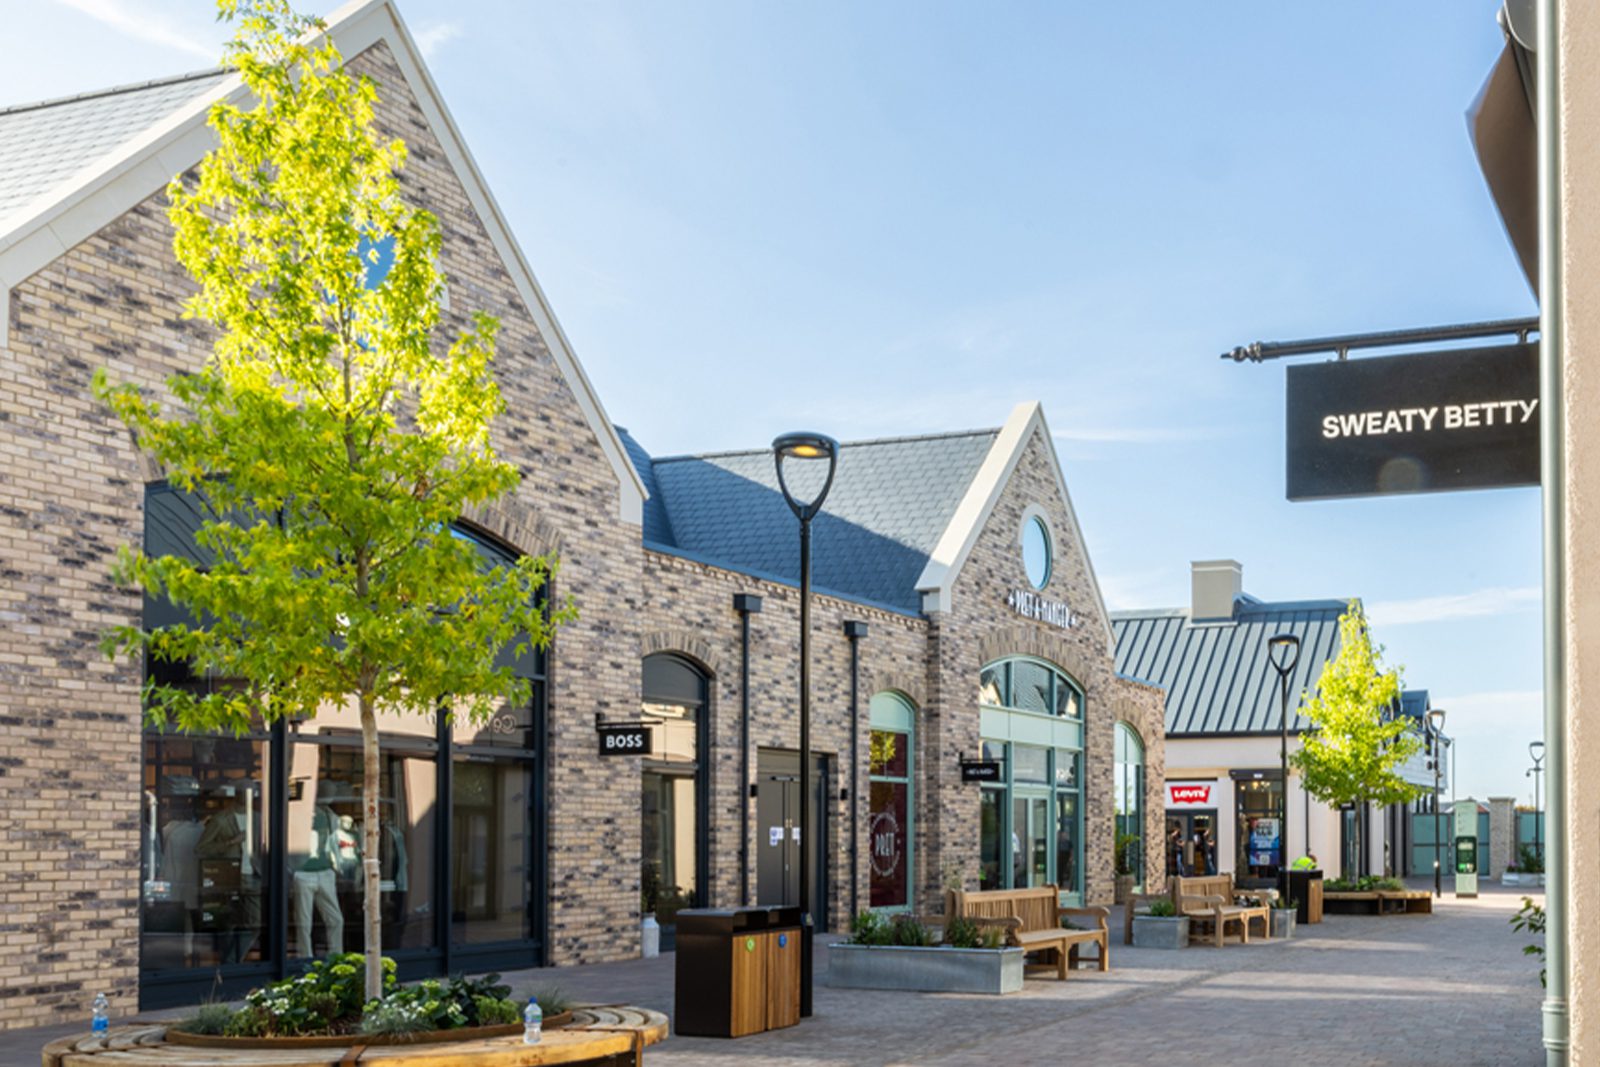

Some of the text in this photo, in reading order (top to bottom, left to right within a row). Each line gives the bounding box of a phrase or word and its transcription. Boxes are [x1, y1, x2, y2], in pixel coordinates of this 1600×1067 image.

[1322, 398, 1538, 438] SWEATY BETTY
[606, 734, 643, 749] BOSS
[875, 832, 895, 857] PRET
